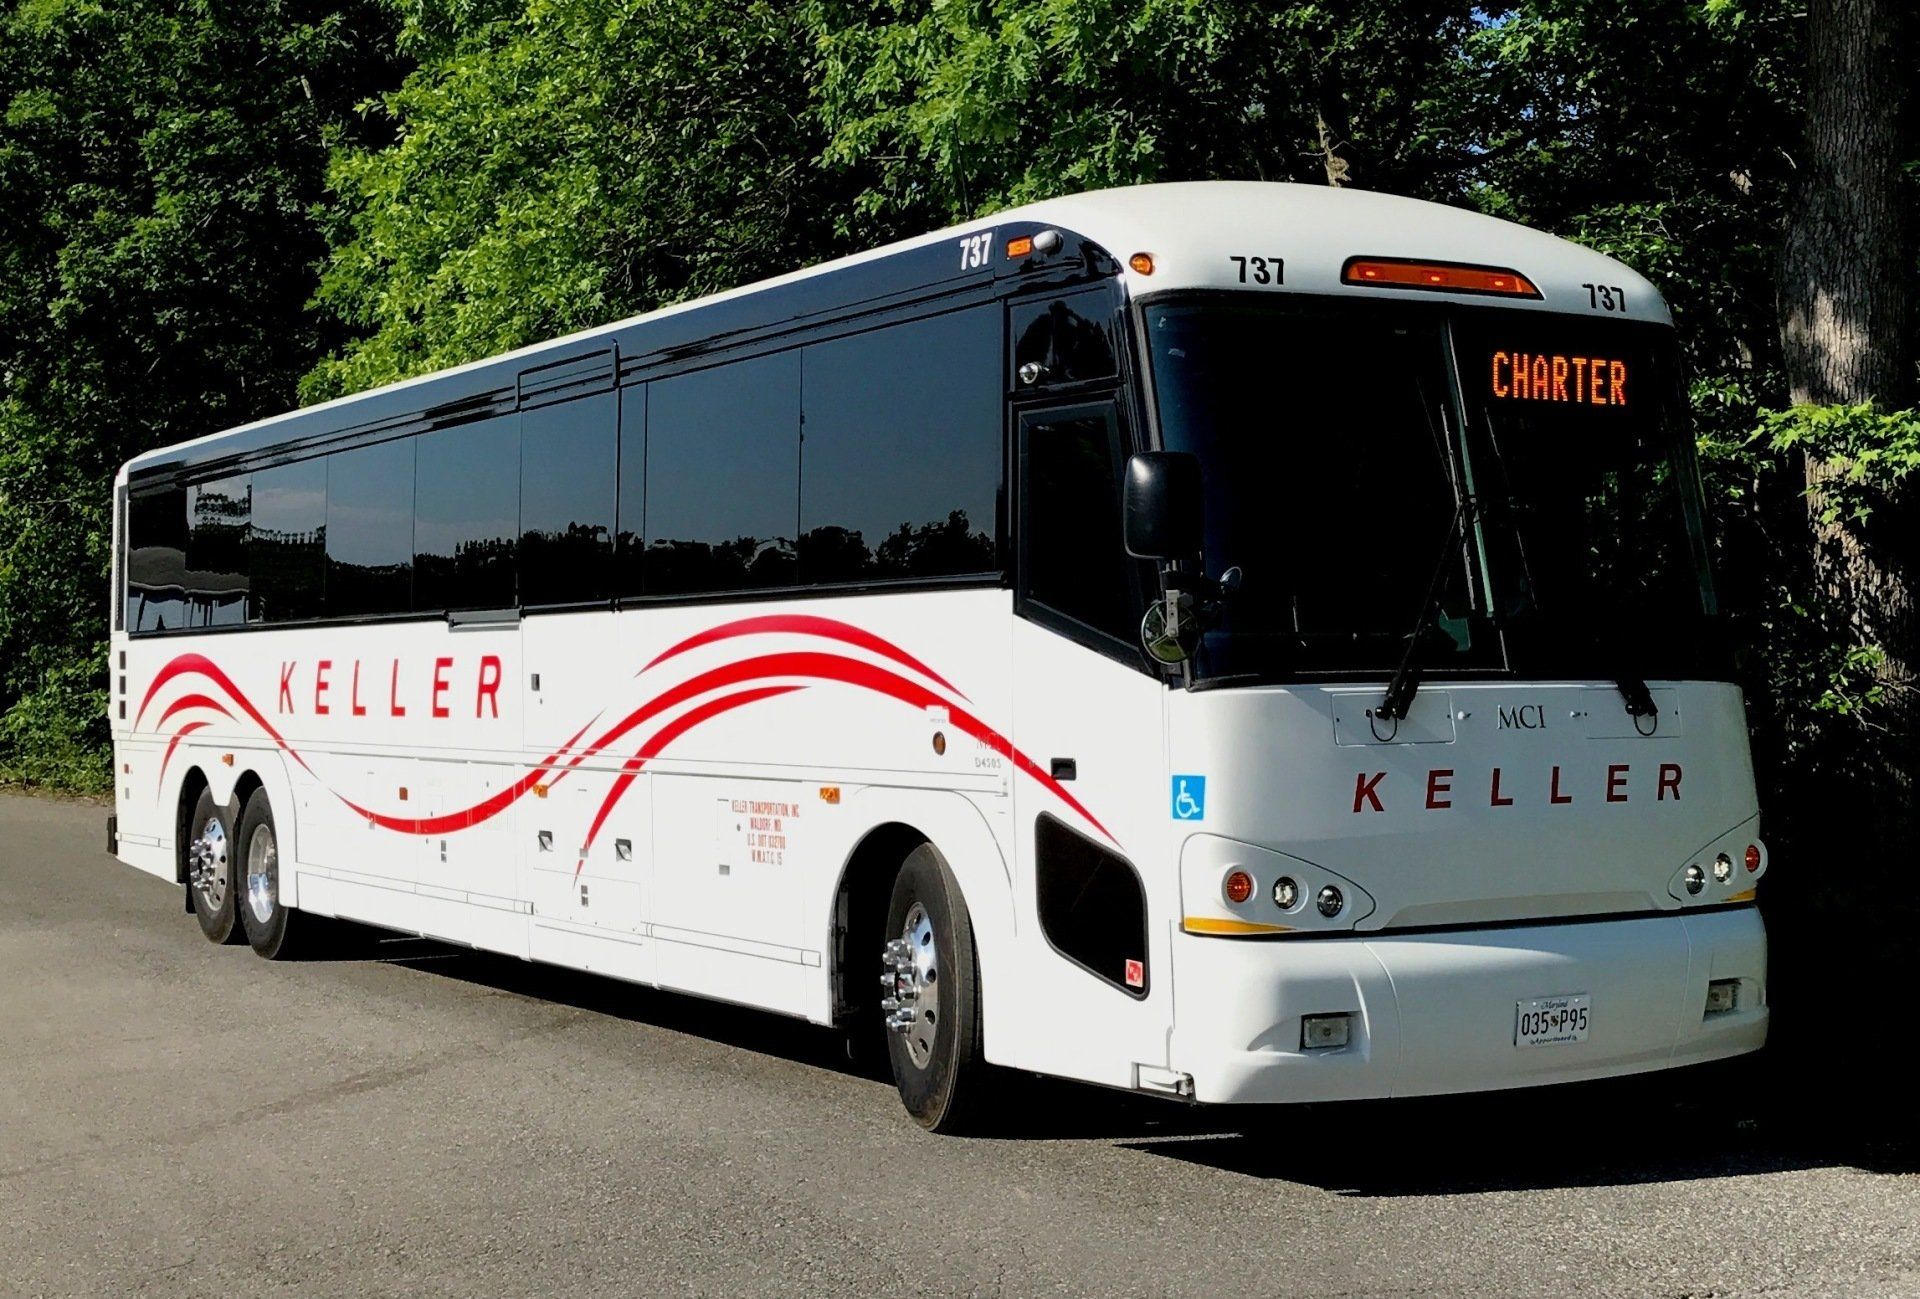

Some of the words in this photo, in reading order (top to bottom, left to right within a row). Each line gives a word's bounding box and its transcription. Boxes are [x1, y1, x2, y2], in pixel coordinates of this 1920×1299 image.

[960, 232, 993, 271] 737
[1230, 256, 1284, 285] 737
[1582, 283, 1626, 312] 737
[1492, 351, 1626, 406] CHARTER
[279, 655, 502, 719] KELLER
[1497, 704, 1547, 730] MCI
[1353, 762, 1683, 813] KELLER
[732, 799, 748, 813] KELLER
[1521, 1010, 1550, 1036] 035
[1559, 1007, 1588, 1033] P95
